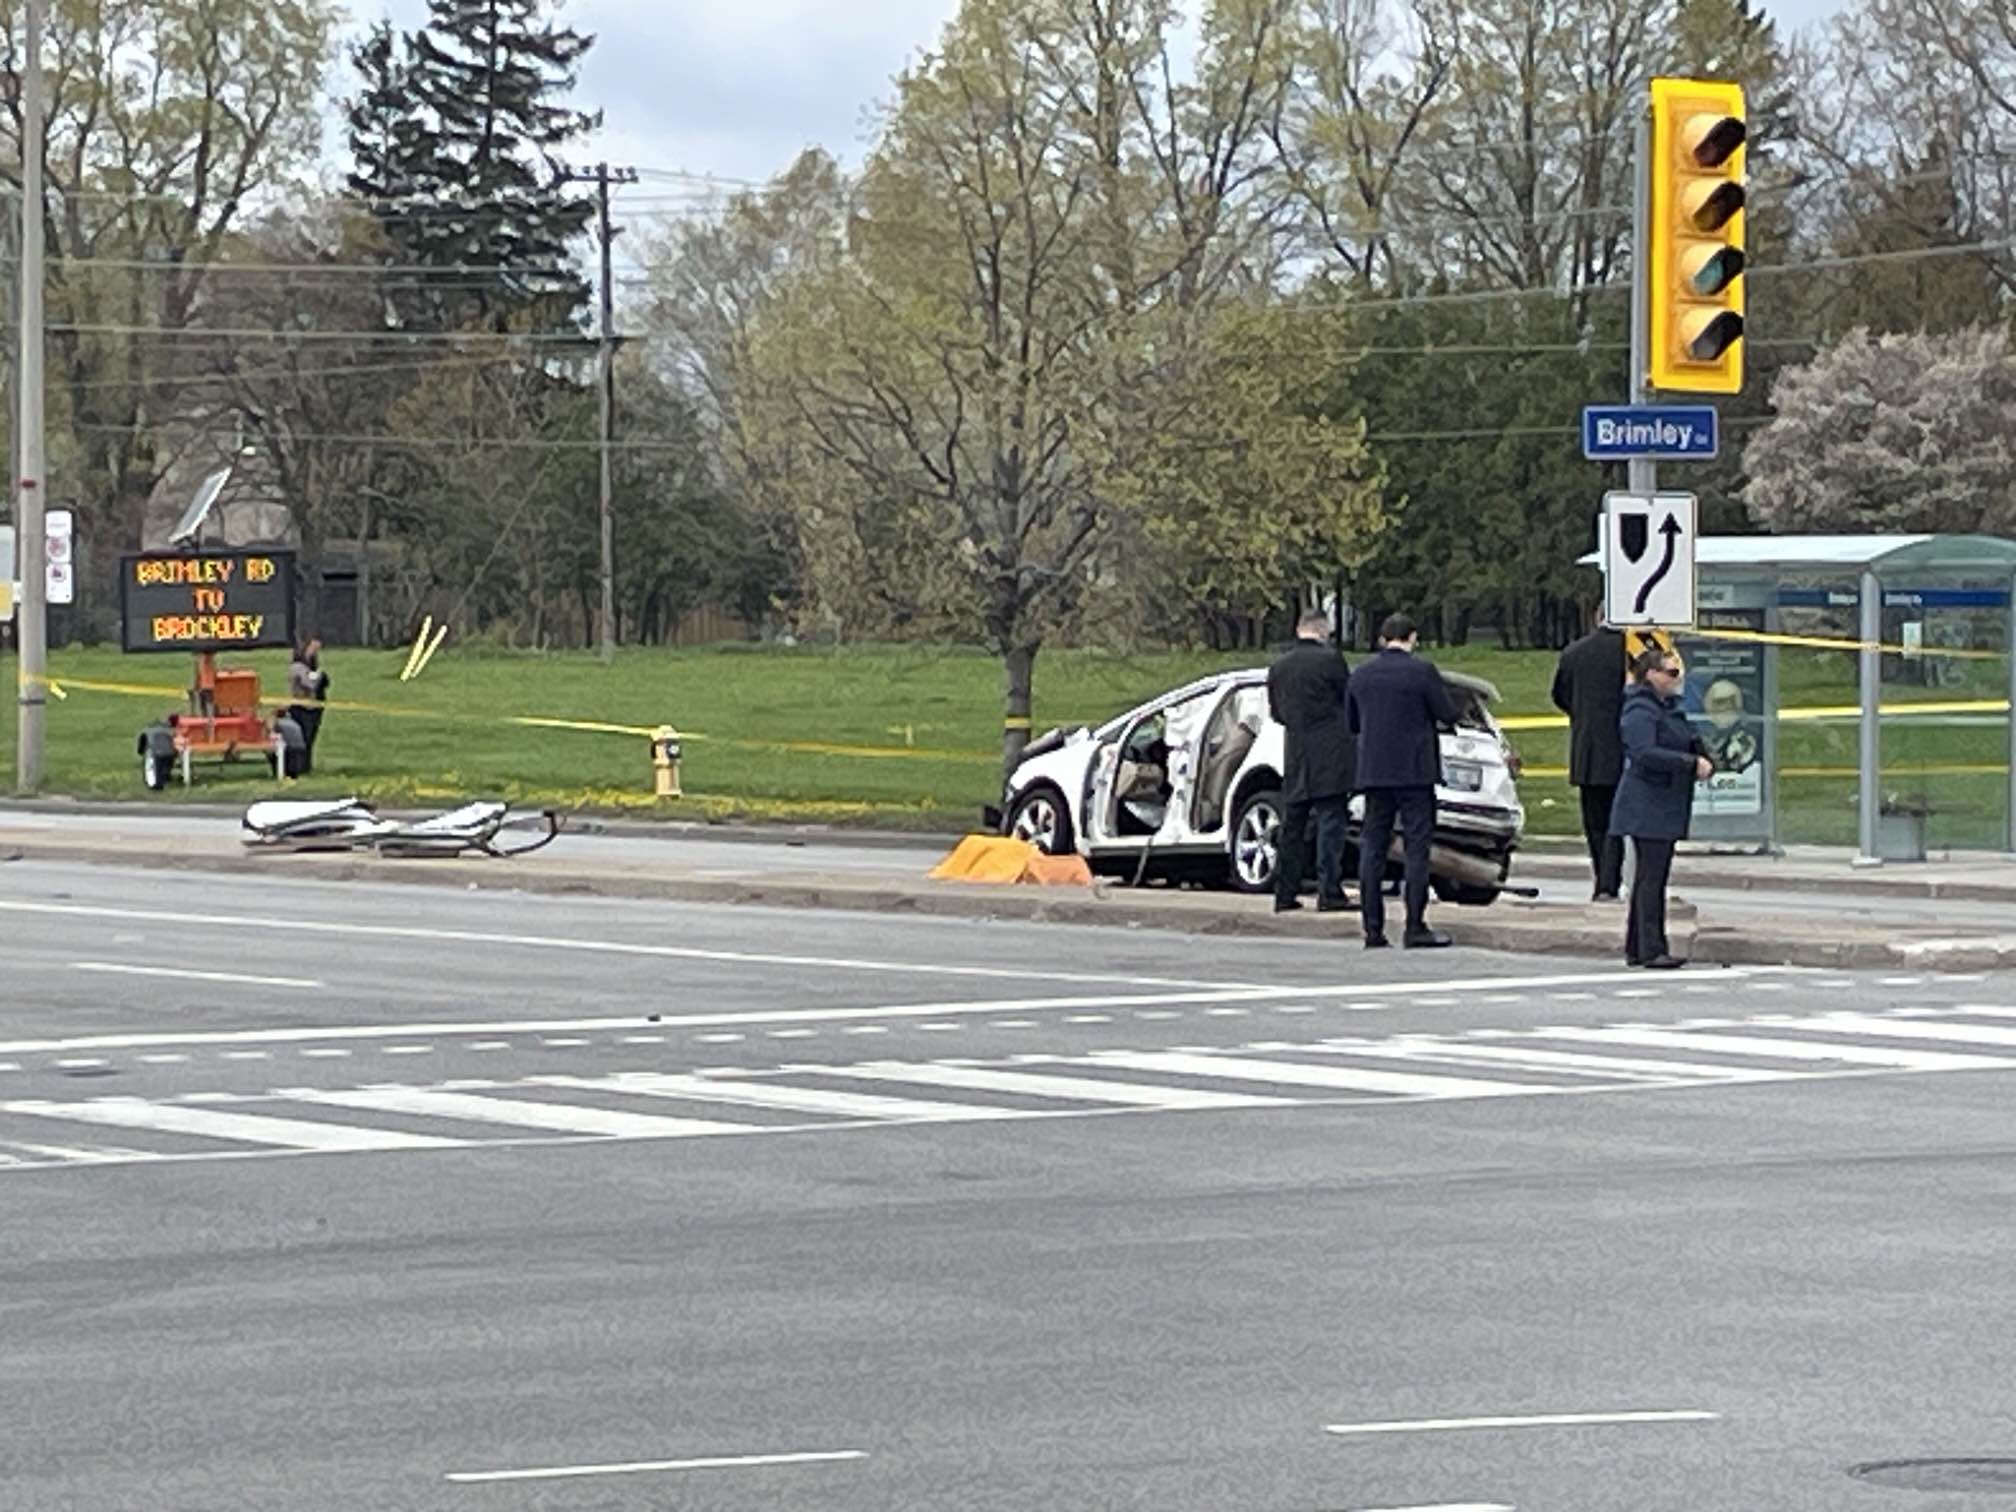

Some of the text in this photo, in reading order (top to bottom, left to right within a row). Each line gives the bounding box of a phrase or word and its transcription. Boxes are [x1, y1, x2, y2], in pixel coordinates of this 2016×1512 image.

[1597, 417, 1693, 450] Brimley
[136, 558, 275, 586] BRIMLEY RD
[153, 615, 263, 641] BROCKLEY
